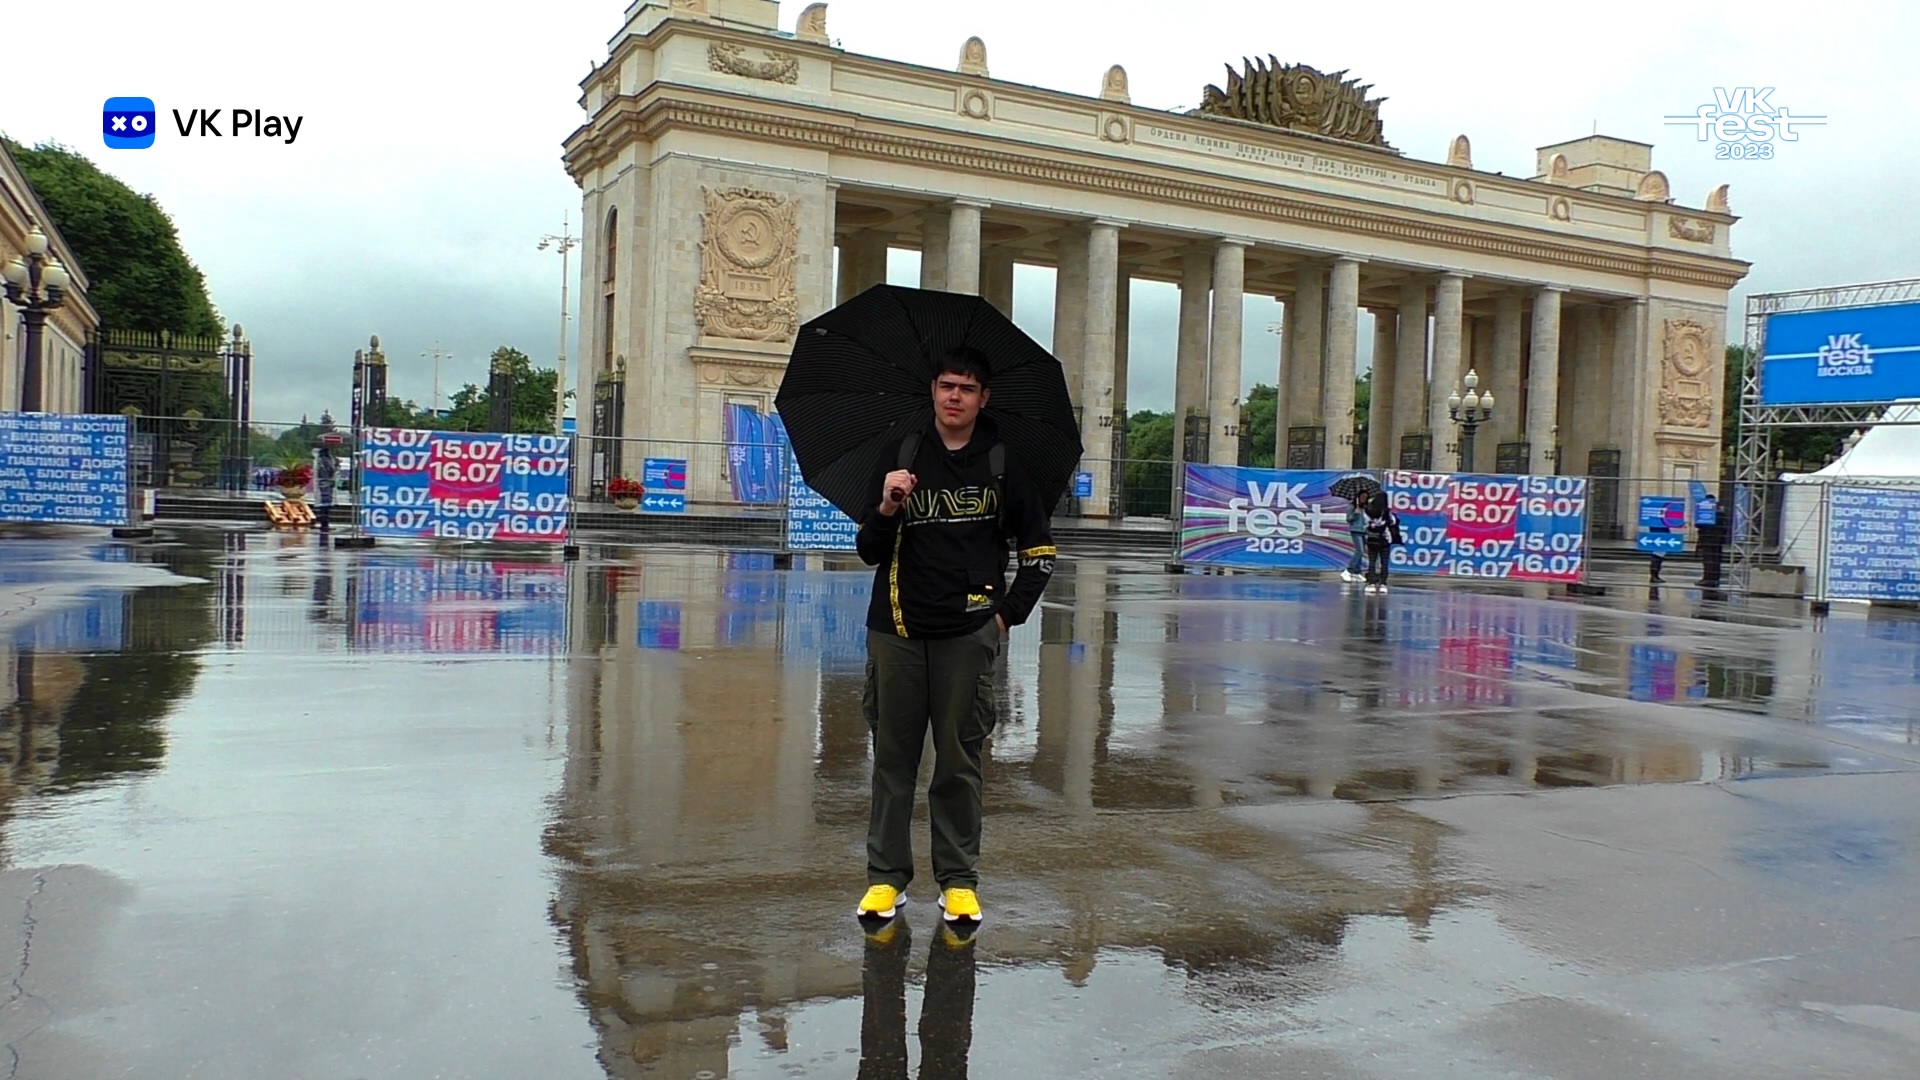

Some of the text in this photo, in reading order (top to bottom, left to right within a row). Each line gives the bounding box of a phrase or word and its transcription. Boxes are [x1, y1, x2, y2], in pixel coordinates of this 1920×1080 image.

[1827, 333, 1863, 350] VK
[1817, 344, 1875, 367] fest
[1817, 366, 1873, 377] МОСКВА
[10, 432, 92, 444] ВИДЕОИГРЫ
[363, 427, 432, 448] 15.07
[502, 434, 571, 454] 15.07
[5, 444, 92, 456] ТЕХНОЛОГИИ
[361, 449, 431, 470] 16.07
[431, 439, 502, 461] 15.07
[8, 456, 70, 468] ПАБЛИКИ
[430, 461, 500, 483] 16.07
[501, 455, 569, 477] 16.07
[36, 469, 102, 480] БЛОГЕРЫ
[1384, 471, 1450, 490] 15.07
[1517, 475, 1587, 495] 15.07
[17, 493, 104, 504] ТВОРЧЕСТВО
[361, 485, 430, 506] 15.07
[499, 491, 568, 512] 15.07
[1247, 481, 1309, 509] VK
[1449, 481, 1518, 502] 15.07
[1, 504, 44, 515] СПОРТ
[54, 507, 101, 517] СЕМЬЯ
[429, 498, 499, 519] 15.07
[1448, 503, 1517, 524] 16.07
[1516, 497, 1586, 517] 16.07
[360, 508, 429, 529] 16.07
[499, 514, 567, 535] 16.07
[1228, 498, 1330, 538] fest
[428, 520, 499, 539] 16.07
[1399, 525, 1447, 545] 5.07
[1245, 537, 1304, 555] 2023
[1446, 537, 1515, 558] 15.07
[1515, 531, 1583, 552] 15.07
[1390, 546, 1446, 567] 6.07
[1513, 553, 1582, 575] 16.07
[1444, 559, 1514, 578] 16.07
